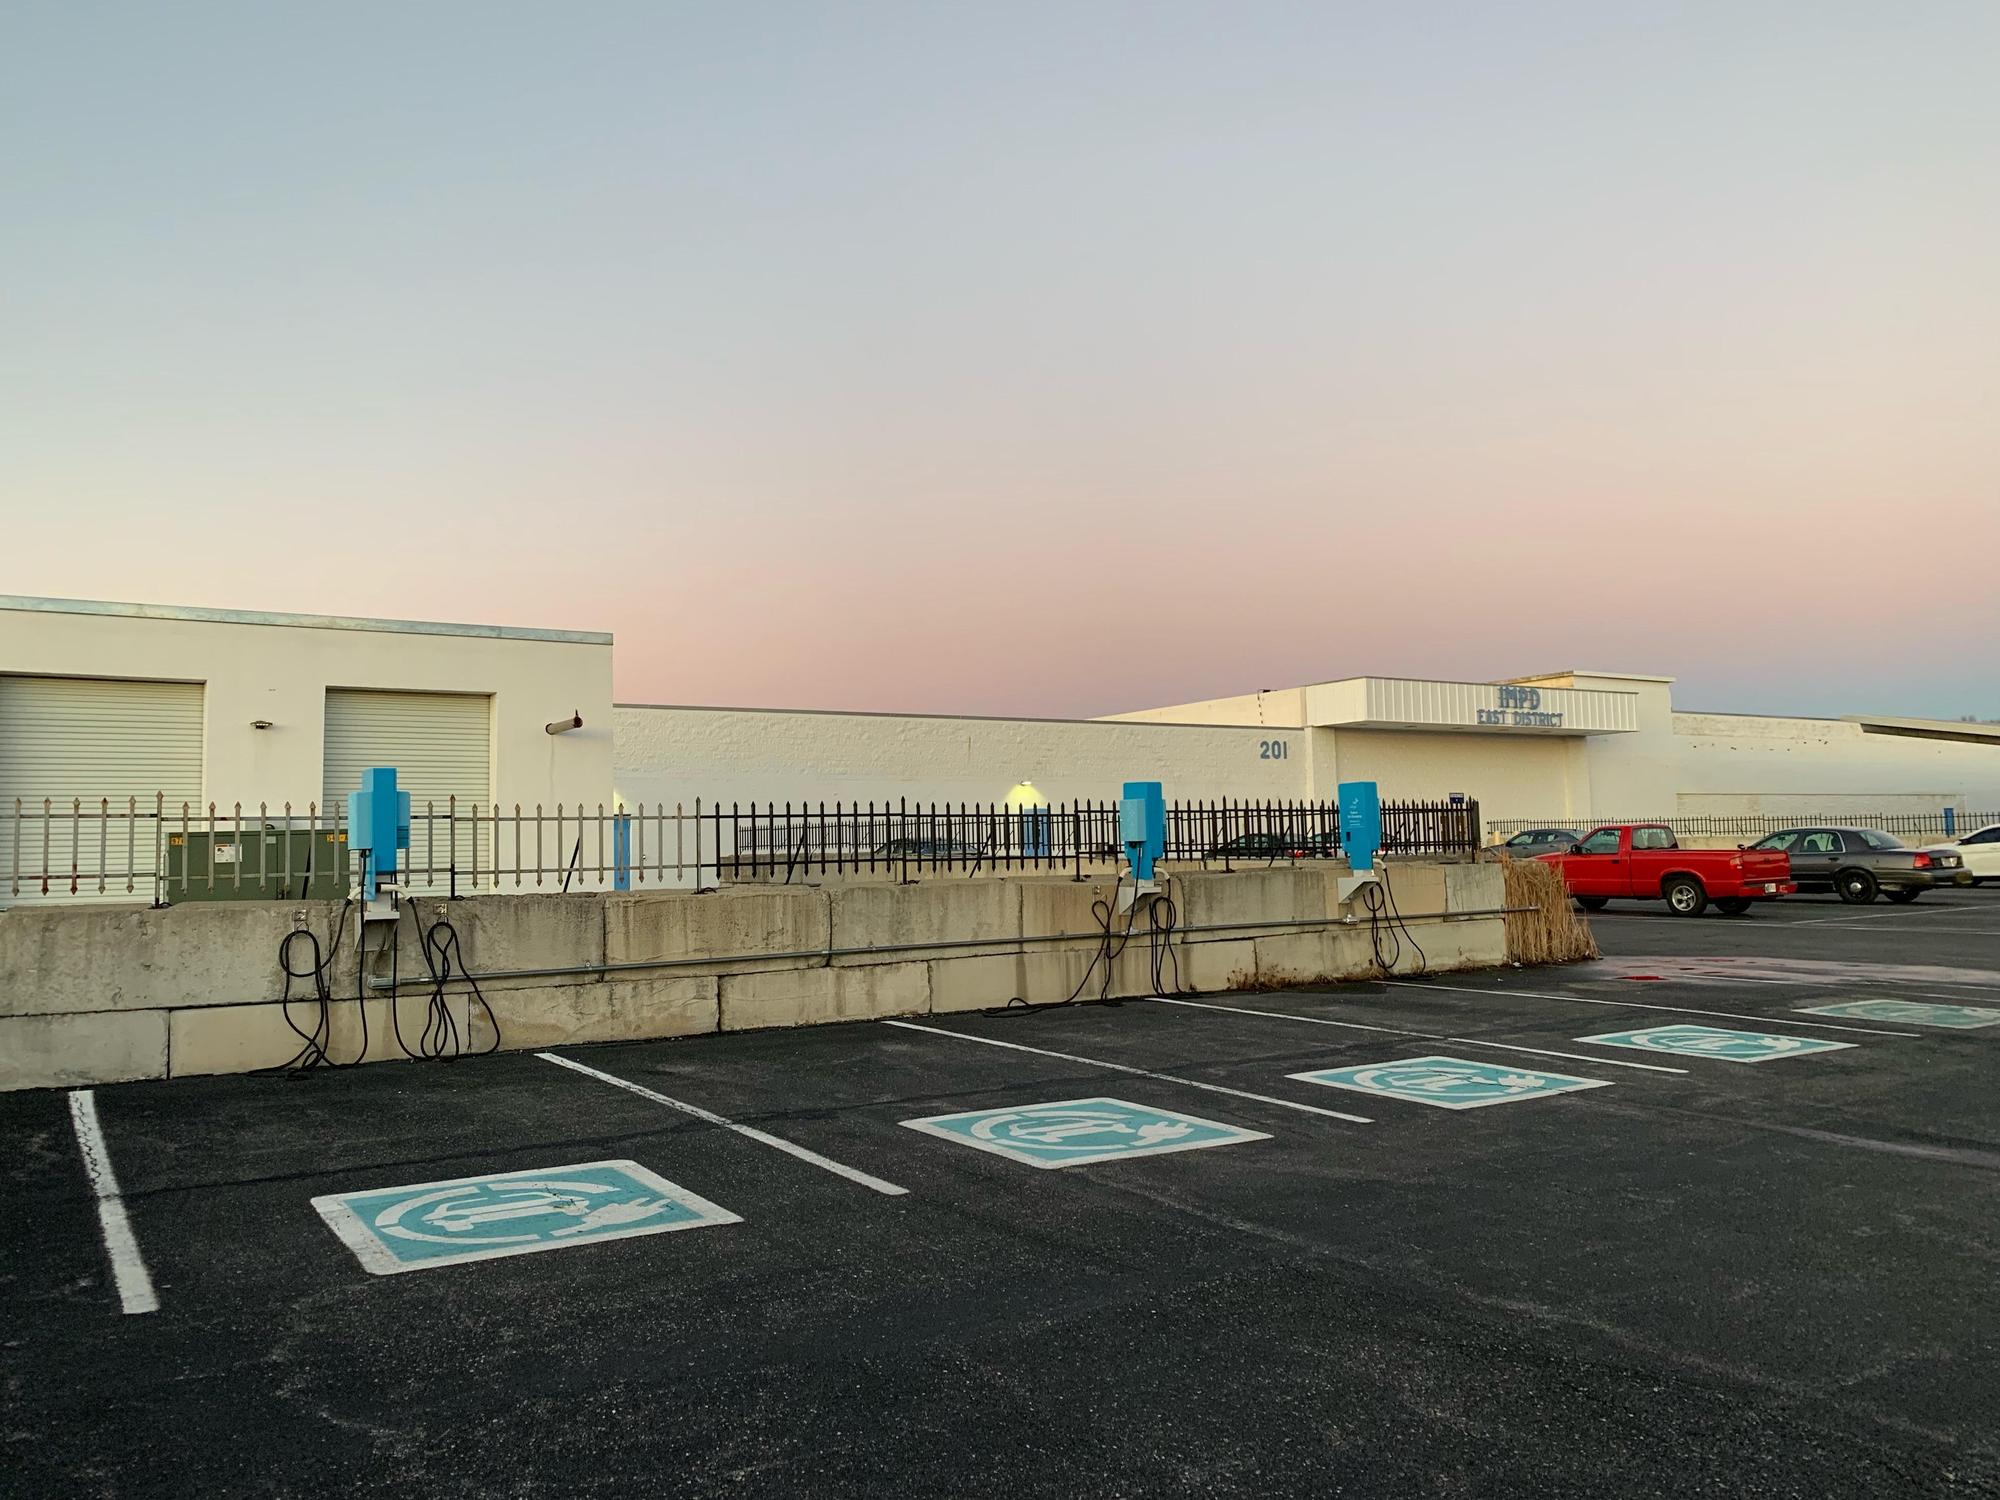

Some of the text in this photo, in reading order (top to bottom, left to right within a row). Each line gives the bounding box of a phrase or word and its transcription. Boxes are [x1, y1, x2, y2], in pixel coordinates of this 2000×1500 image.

[1477, 709, 1563, 728] EAST DISTRICT
[1260, 740, 1288, 760] 201
